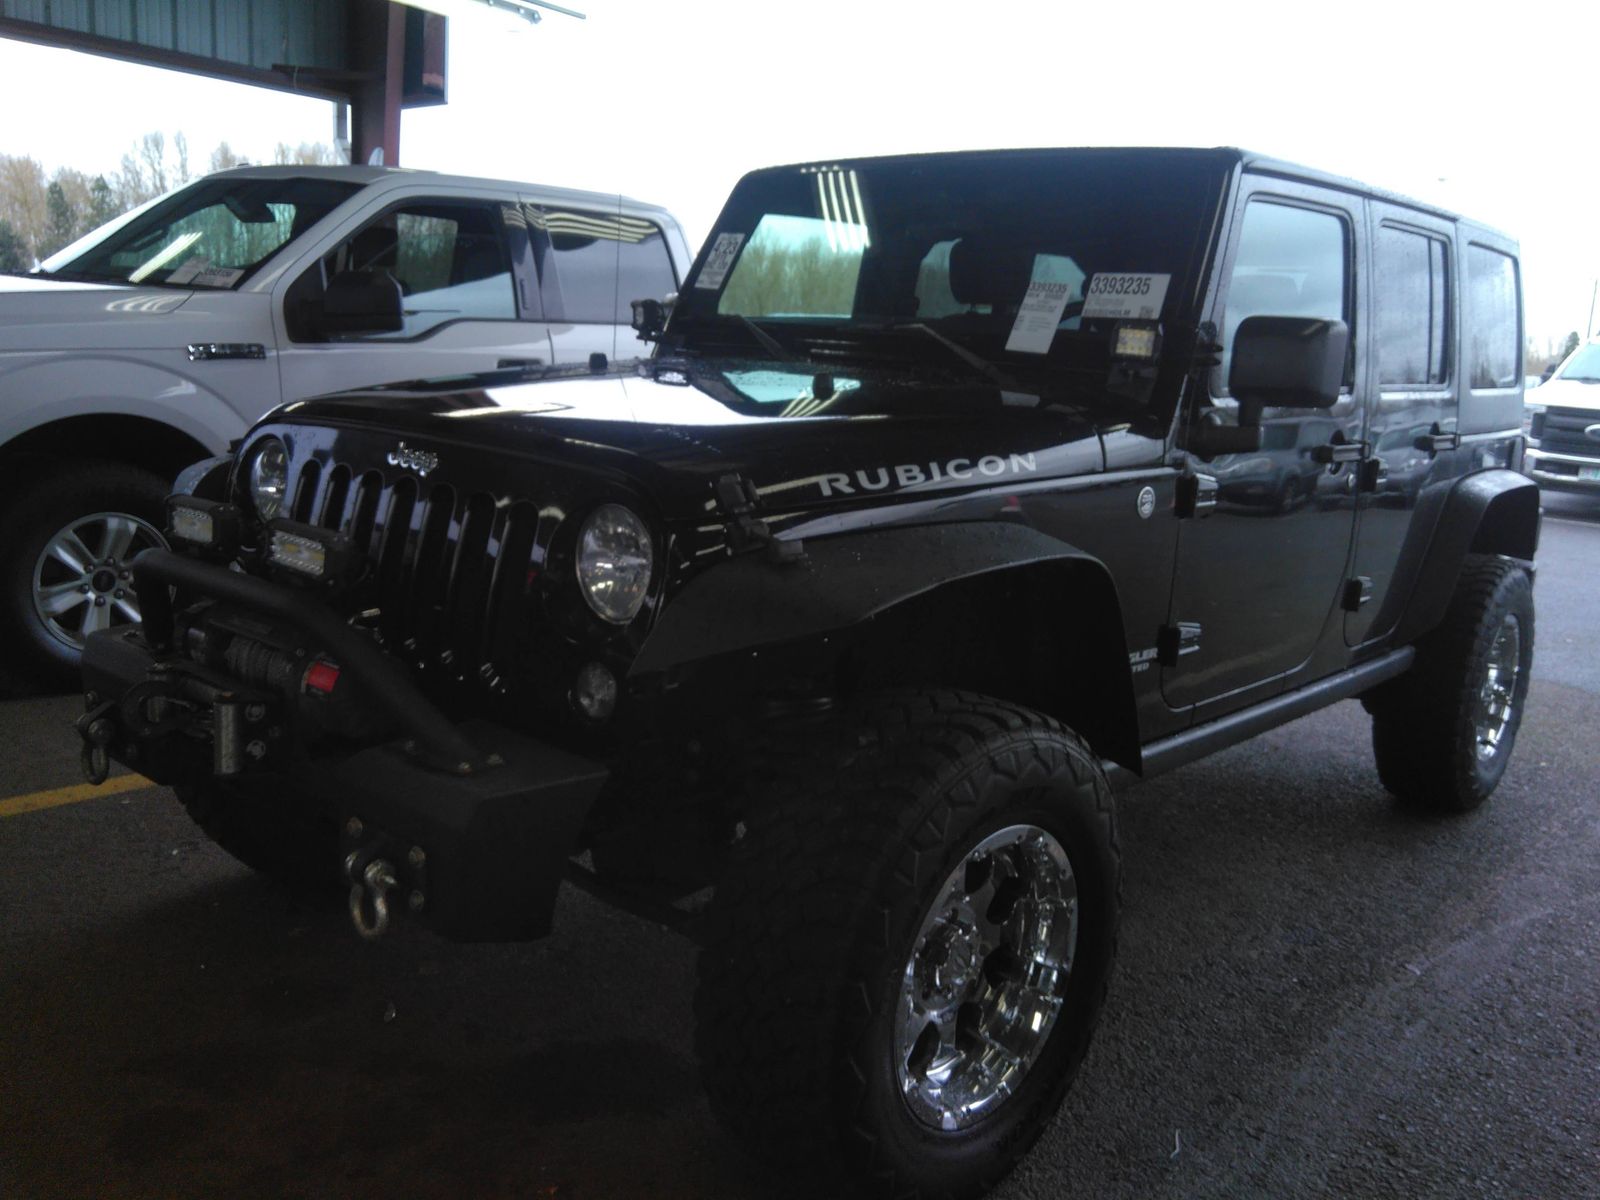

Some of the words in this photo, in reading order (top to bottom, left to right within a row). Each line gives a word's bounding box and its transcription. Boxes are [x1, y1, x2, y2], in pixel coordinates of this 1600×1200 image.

[1090, 276, 1152, 296] 3393235
[387, 441, 438, 477] Jeep
[816, 453, 1037, 497] RUBICON
[1132, 662, 1149, 673] TED
